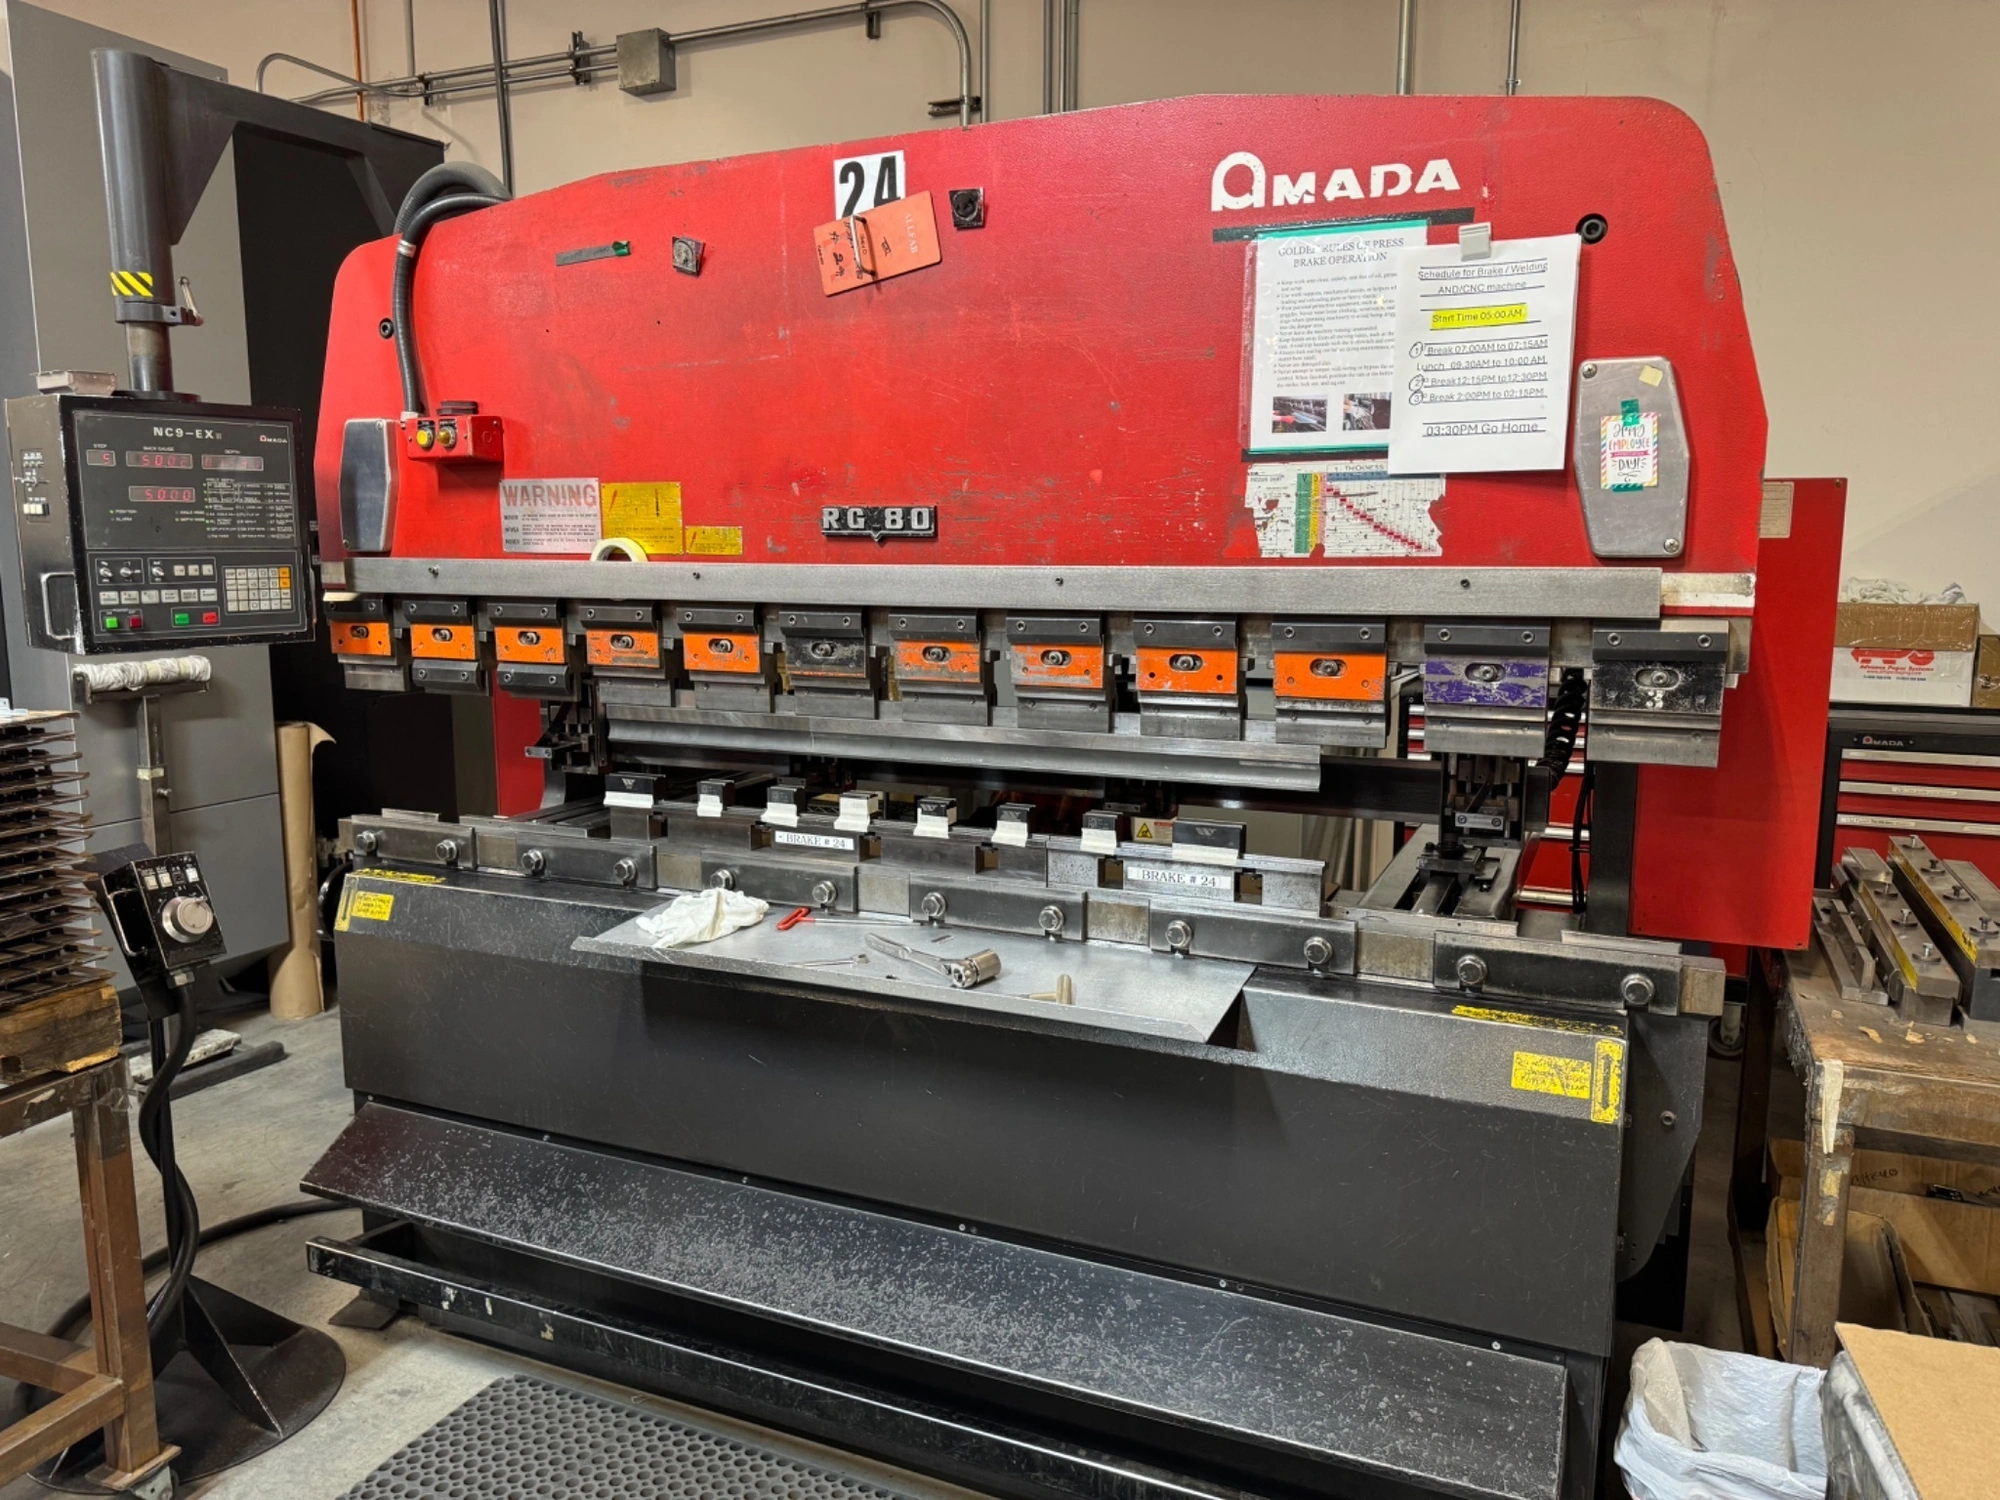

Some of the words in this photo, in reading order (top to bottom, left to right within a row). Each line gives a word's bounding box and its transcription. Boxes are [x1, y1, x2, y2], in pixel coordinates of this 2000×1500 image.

[1211, 151, 1461, 212] AMADA
[1373, 238, 1404, 249] PRESS
[1294, 255, 1327, 268] BRAKE
[1418, 268, 1461, 280] Schedule
[1463, 267, 1475, 277] for
[1477, 265, 1503, 276] Brake
[1511, 261, 1548, 273] Welding
[1438, 283, 1485, 294] AND/CNC
[1487, 281, 1527, 292] machine
[1432, 313, 1454, 323] Start
[1456, 312, 1478, 321] Time
[1508, 308, 1522, 318] AM
[1427, 345, 1453, 354] Break
[1497, 341, 1506, 350] to
[1417, 361, 1445, 371] Lunch
[1493, 358, 1501, 367] to
[1505, 356, 1528, 366] 10:00
[1531, 355, 1545, 364] AM
[1429, 391, 1454, 401] Break
[1493, 389, 1501, 398] to
[153, 426, 214, 439] NC9-EX
[1427, 425, 1478, 437] 03:30PM
[1481, 424, 1498, 434] Go
[1501, 422, 1538, 433] Home
[502, 484, 597, 508] WARNING
[822, 507, 865, 529] RG
[884, 507, 930, 530] 80
[786, 833, 821, 846] BRAKE
[832, 838, 846, 848] 24
[1142, 869, 1186, 884] BRAKE
[1189, 876, 1196, 884] #
[1200, 875, 1216, 887] 24
